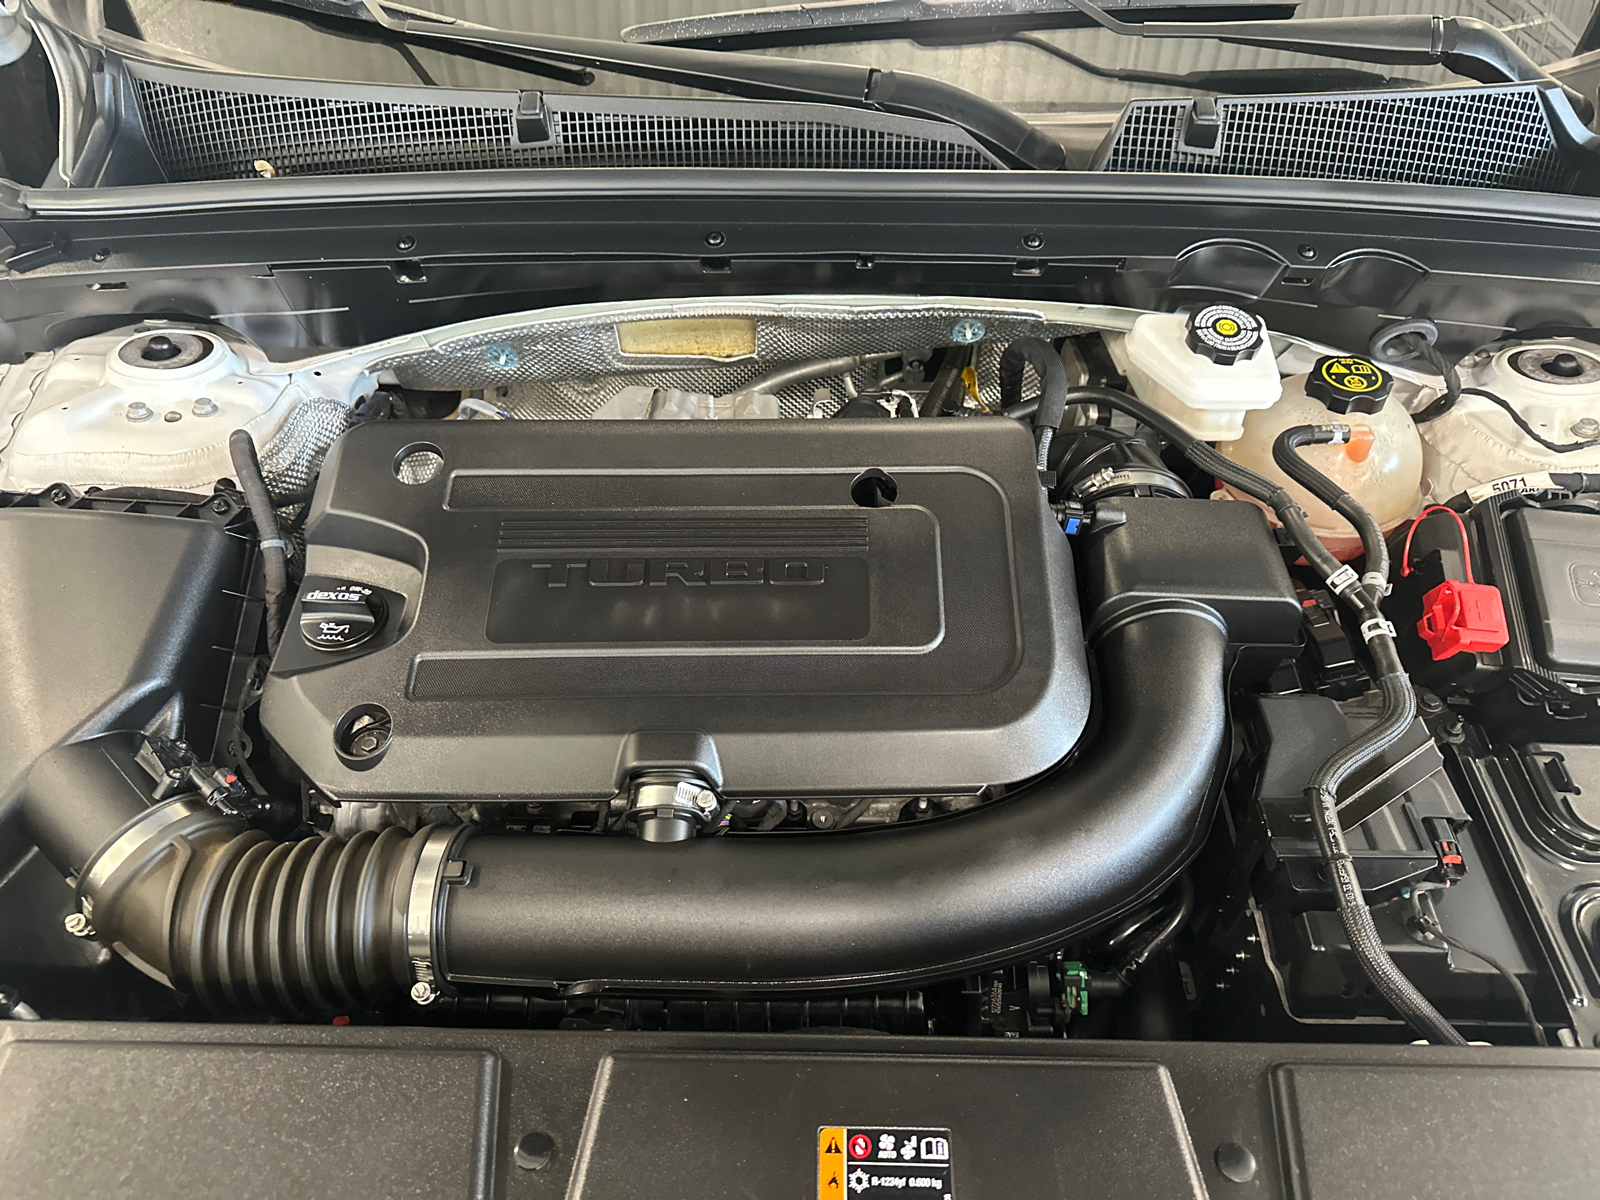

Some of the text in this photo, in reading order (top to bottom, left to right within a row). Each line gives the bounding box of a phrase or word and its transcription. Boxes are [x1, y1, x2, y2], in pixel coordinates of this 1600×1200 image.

[531, 559, 828, 588] TURBO
[306, 590, 363, 602] dexos
[877, 1150, 898, 1160] AUTO
[871, 1176, 907, 1189] R-1234yf
[931, 1177, 942, 1190] kg
